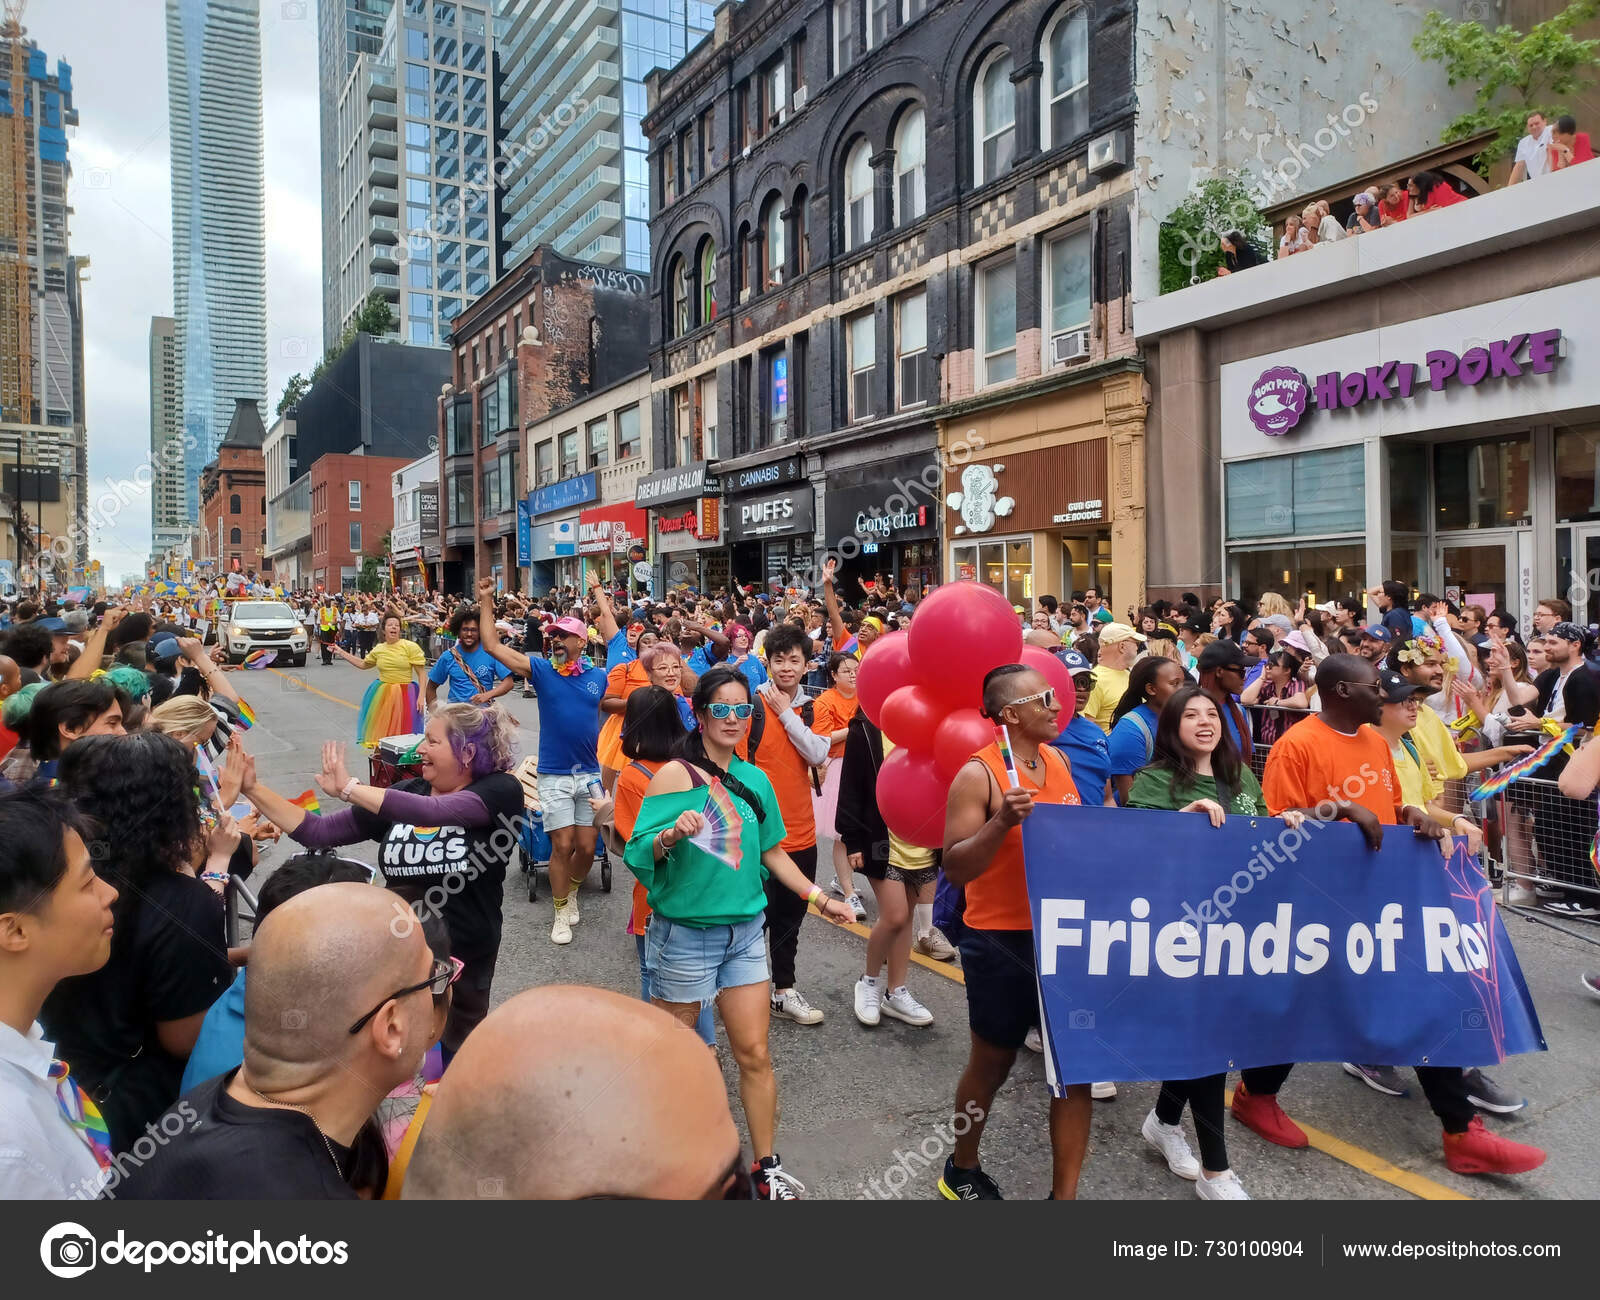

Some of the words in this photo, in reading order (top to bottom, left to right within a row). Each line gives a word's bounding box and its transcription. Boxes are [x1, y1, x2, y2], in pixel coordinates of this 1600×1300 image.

[1313, 360, 1417, 410] HOKI
[1426, 328, 1562, 391] POKE
[1254, 381, 1276, 399] HOKI
[1276, 378, 1300, 393] POKE
[637, 481, 661, 500] DREAM
[660, 475, 678, 495] HAIR
[678, 468, 704, 491] SALON
[739, 465, 780, 487] CANNABIS
[741, 498, 794, 525] PUFFS
[856, 512, 891, 537] Gong
[893, 507, 917, 529] cha
[1053, 514, 1072, 523] RICE
[1072, 510, 1102, 521] NOODLE
[863, 543, 879, 554] OPEN
[384, 838, 467, 866] HUGS
[384, 865, 426, 876] SOUTHERN
[426, 861, 468, 876] ONTARIO
[1041, 898, 1329, 978] Friends
[1346, 903, 1403, 975] of
